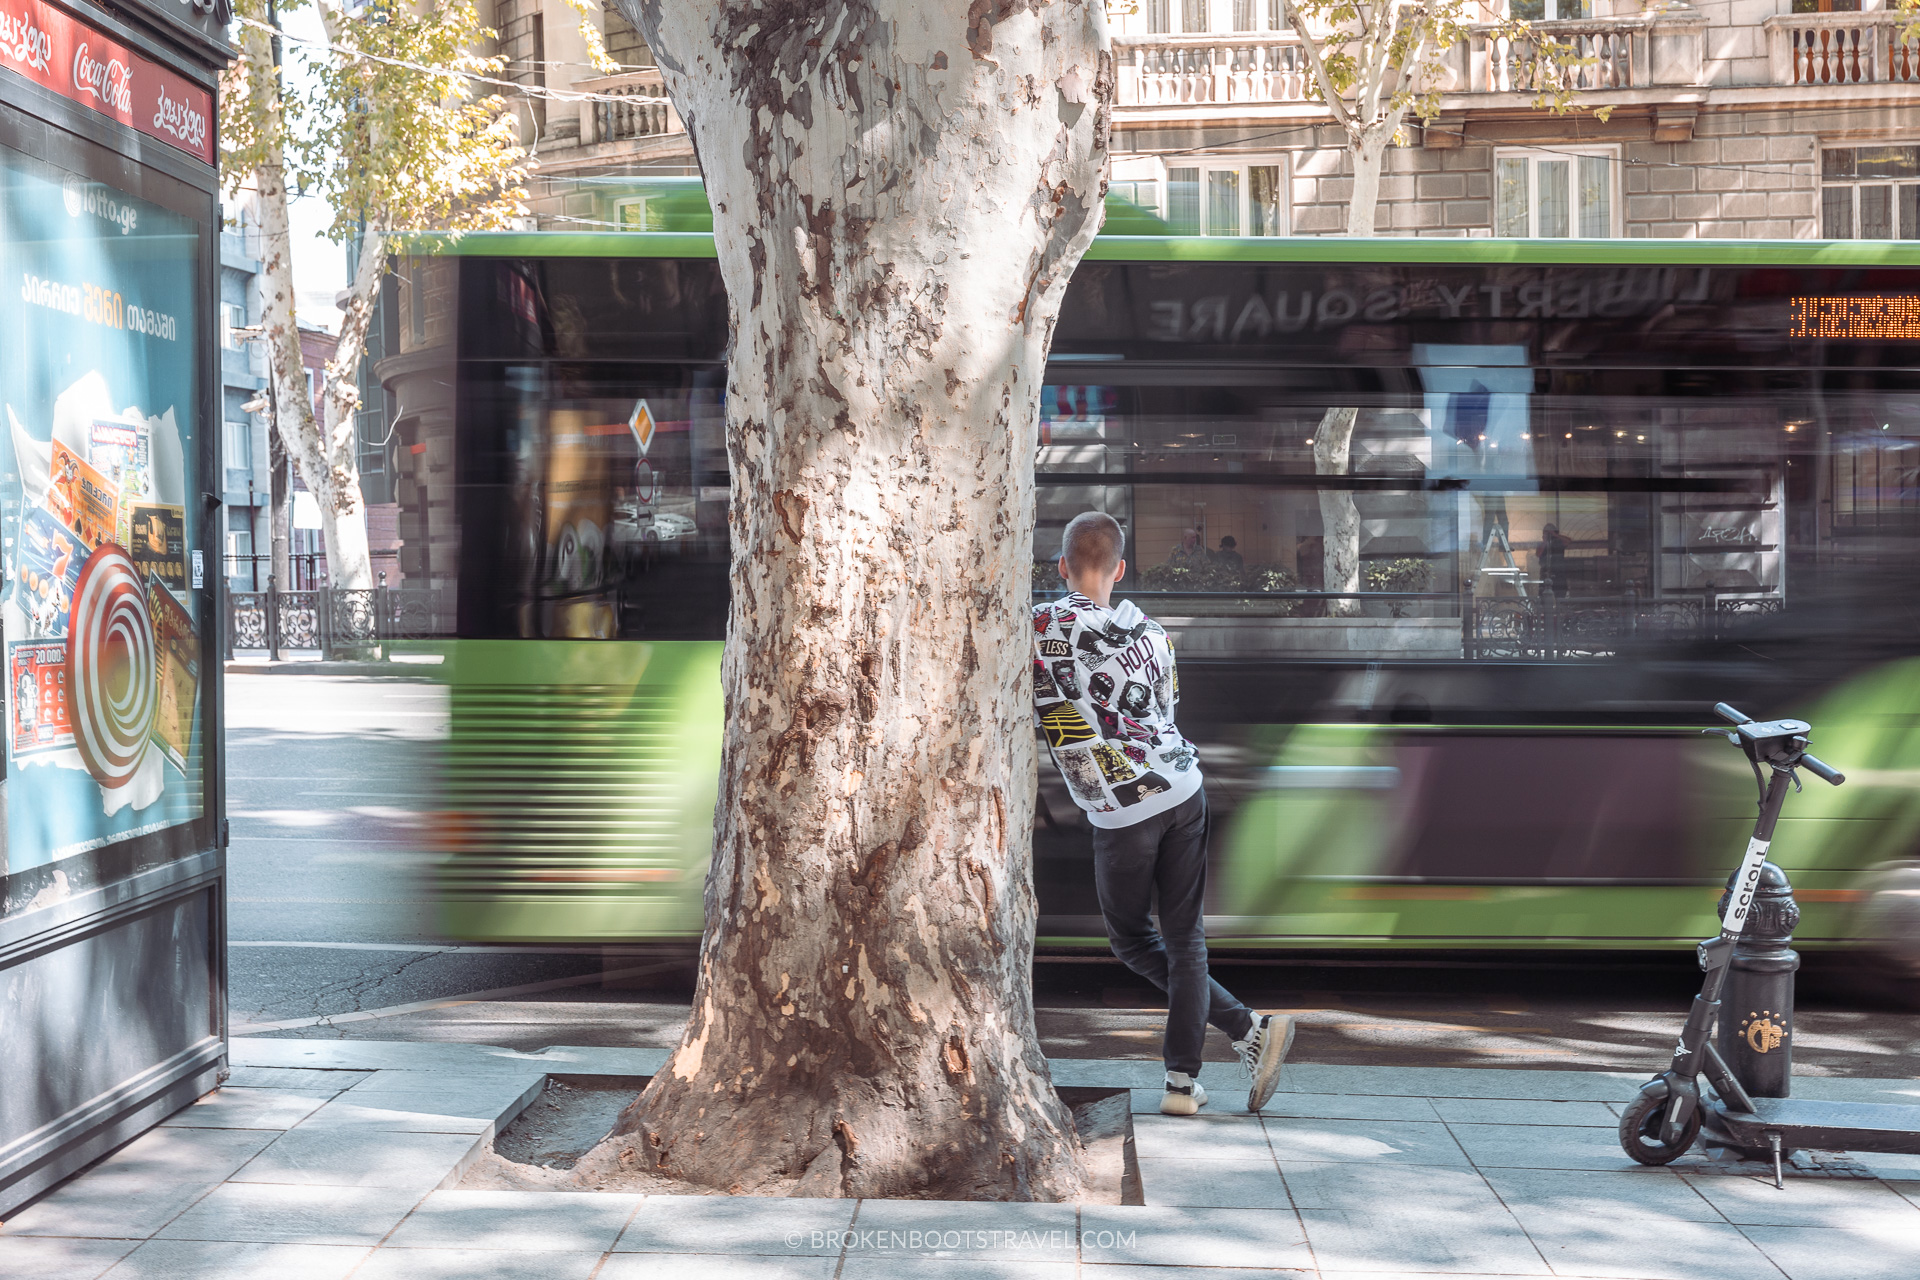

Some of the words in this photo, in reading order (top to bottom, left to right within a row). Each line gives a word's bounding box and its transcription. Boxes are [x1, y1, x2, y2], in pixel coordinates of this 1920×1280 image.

[73, 42, 133, 115] Coca-Cola
[83, 188, 137, 235] lotto.ge
[82, 282, 123, 330] შენი
[35, 648, 46, 665] 20
[1045, 641, 1069, 655] LESS
[1115, 635, 1154, 677] HOLD
[1144, 657, 1161, 686] ON
